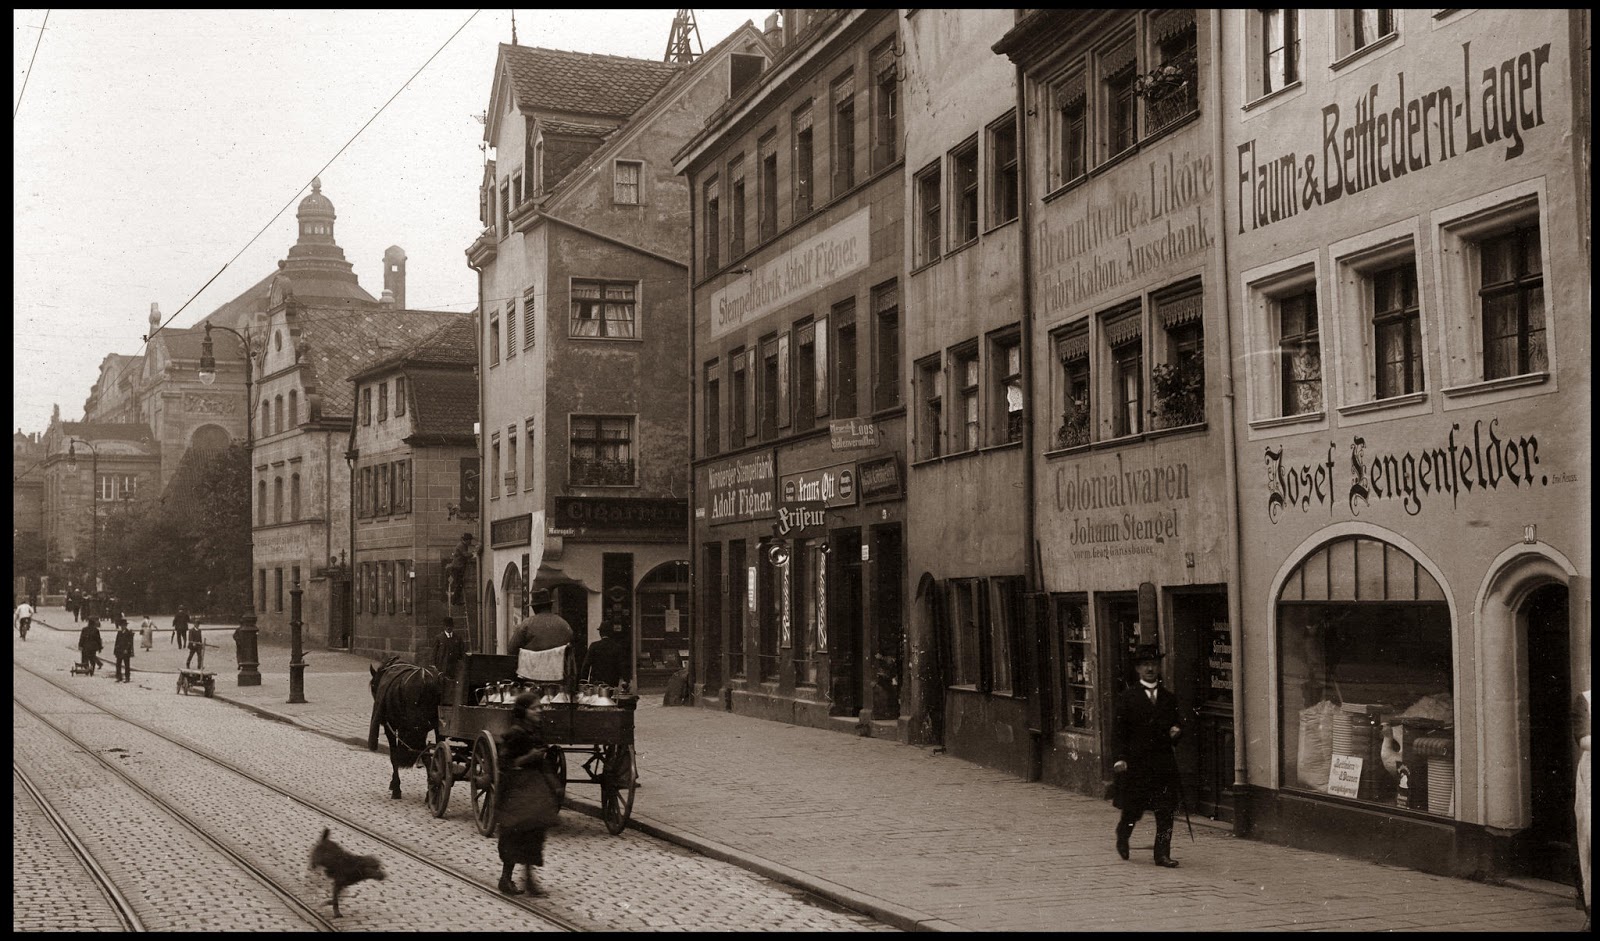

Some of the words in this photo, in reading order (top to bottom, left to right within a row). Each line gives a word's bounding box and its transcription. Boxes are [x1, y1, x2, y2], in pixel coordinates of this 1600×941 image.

[1150, 151, 1214, 221] Liköre
[1302, 153, 1322, 211] &
[784, 250, 813, 294] Adolf
[797, 477, 820, 501] Franz
[821, 472, 835, 501] Ott
[1055, 453, 1190, 512] Colonialwaren
[1265, 441, 1337, 524] Josef
[1350, 418, 1547, 516] Lengenfelder.
[712, 490, 736, 519] Adolf
[1070, 517, 1120, 545] Johann
[1123, 508, 1180, 544] Stengel
[1524, 526, 1534, 541] 40
